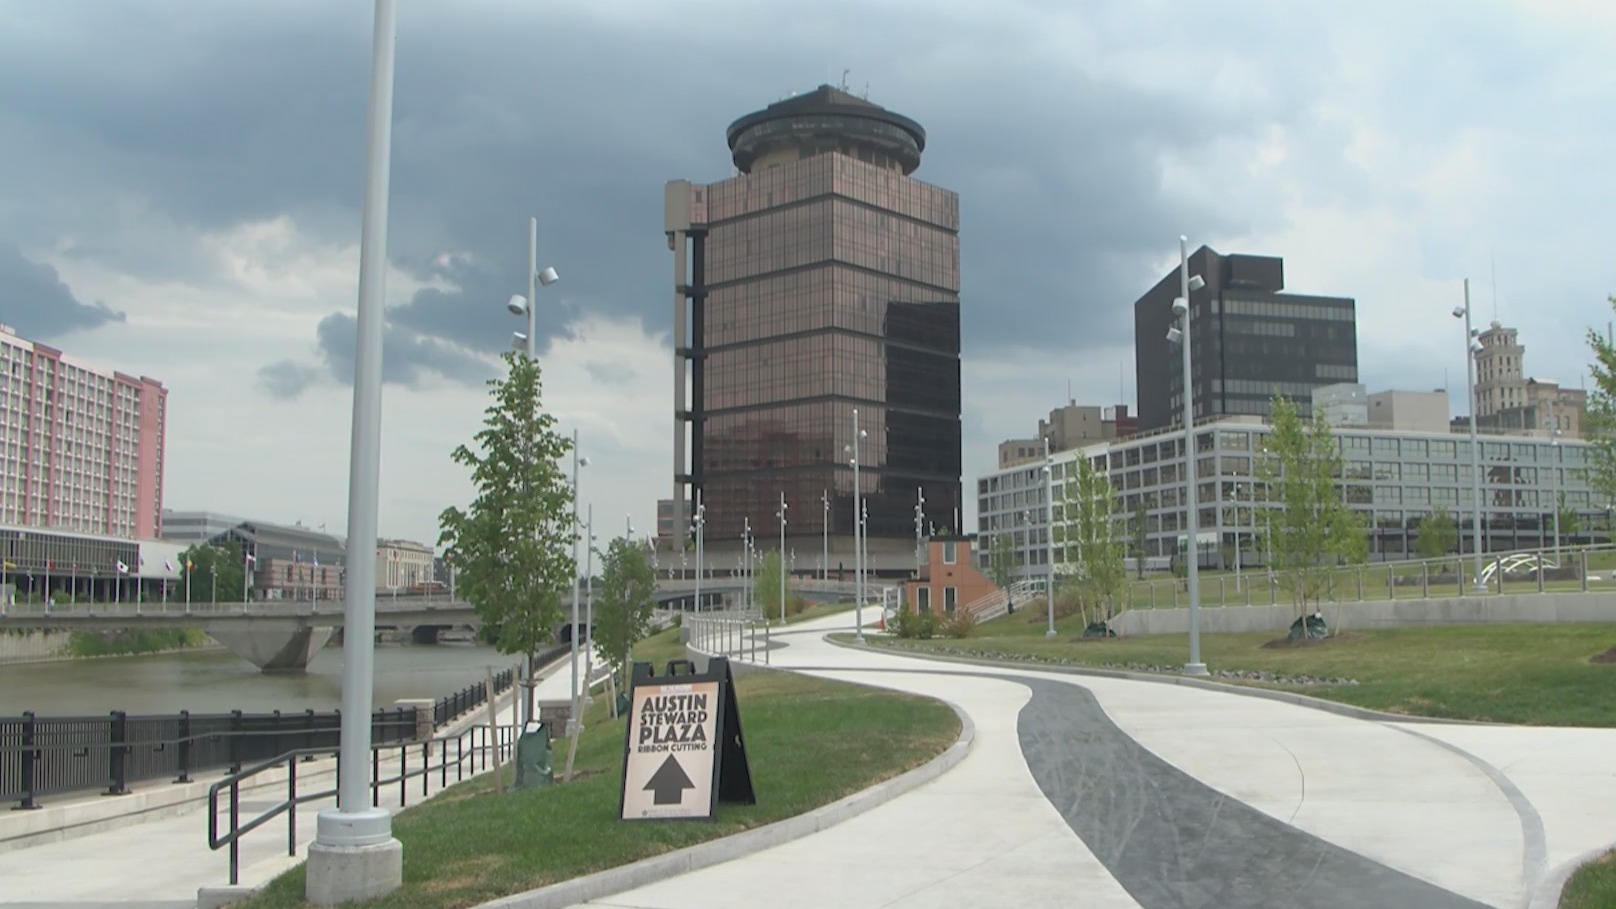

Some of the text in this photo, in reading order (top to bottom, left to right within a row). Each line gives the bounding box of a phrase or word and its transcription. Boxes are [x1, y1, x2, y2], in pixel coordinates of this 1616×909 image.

[641, 694, 707, 713] AUSTIN
[640, 711, 708, 726] STEWARD
[639, 724, 707, 744] PLAZA
[638, 743, 707, 753] RIBBON CUTTING
